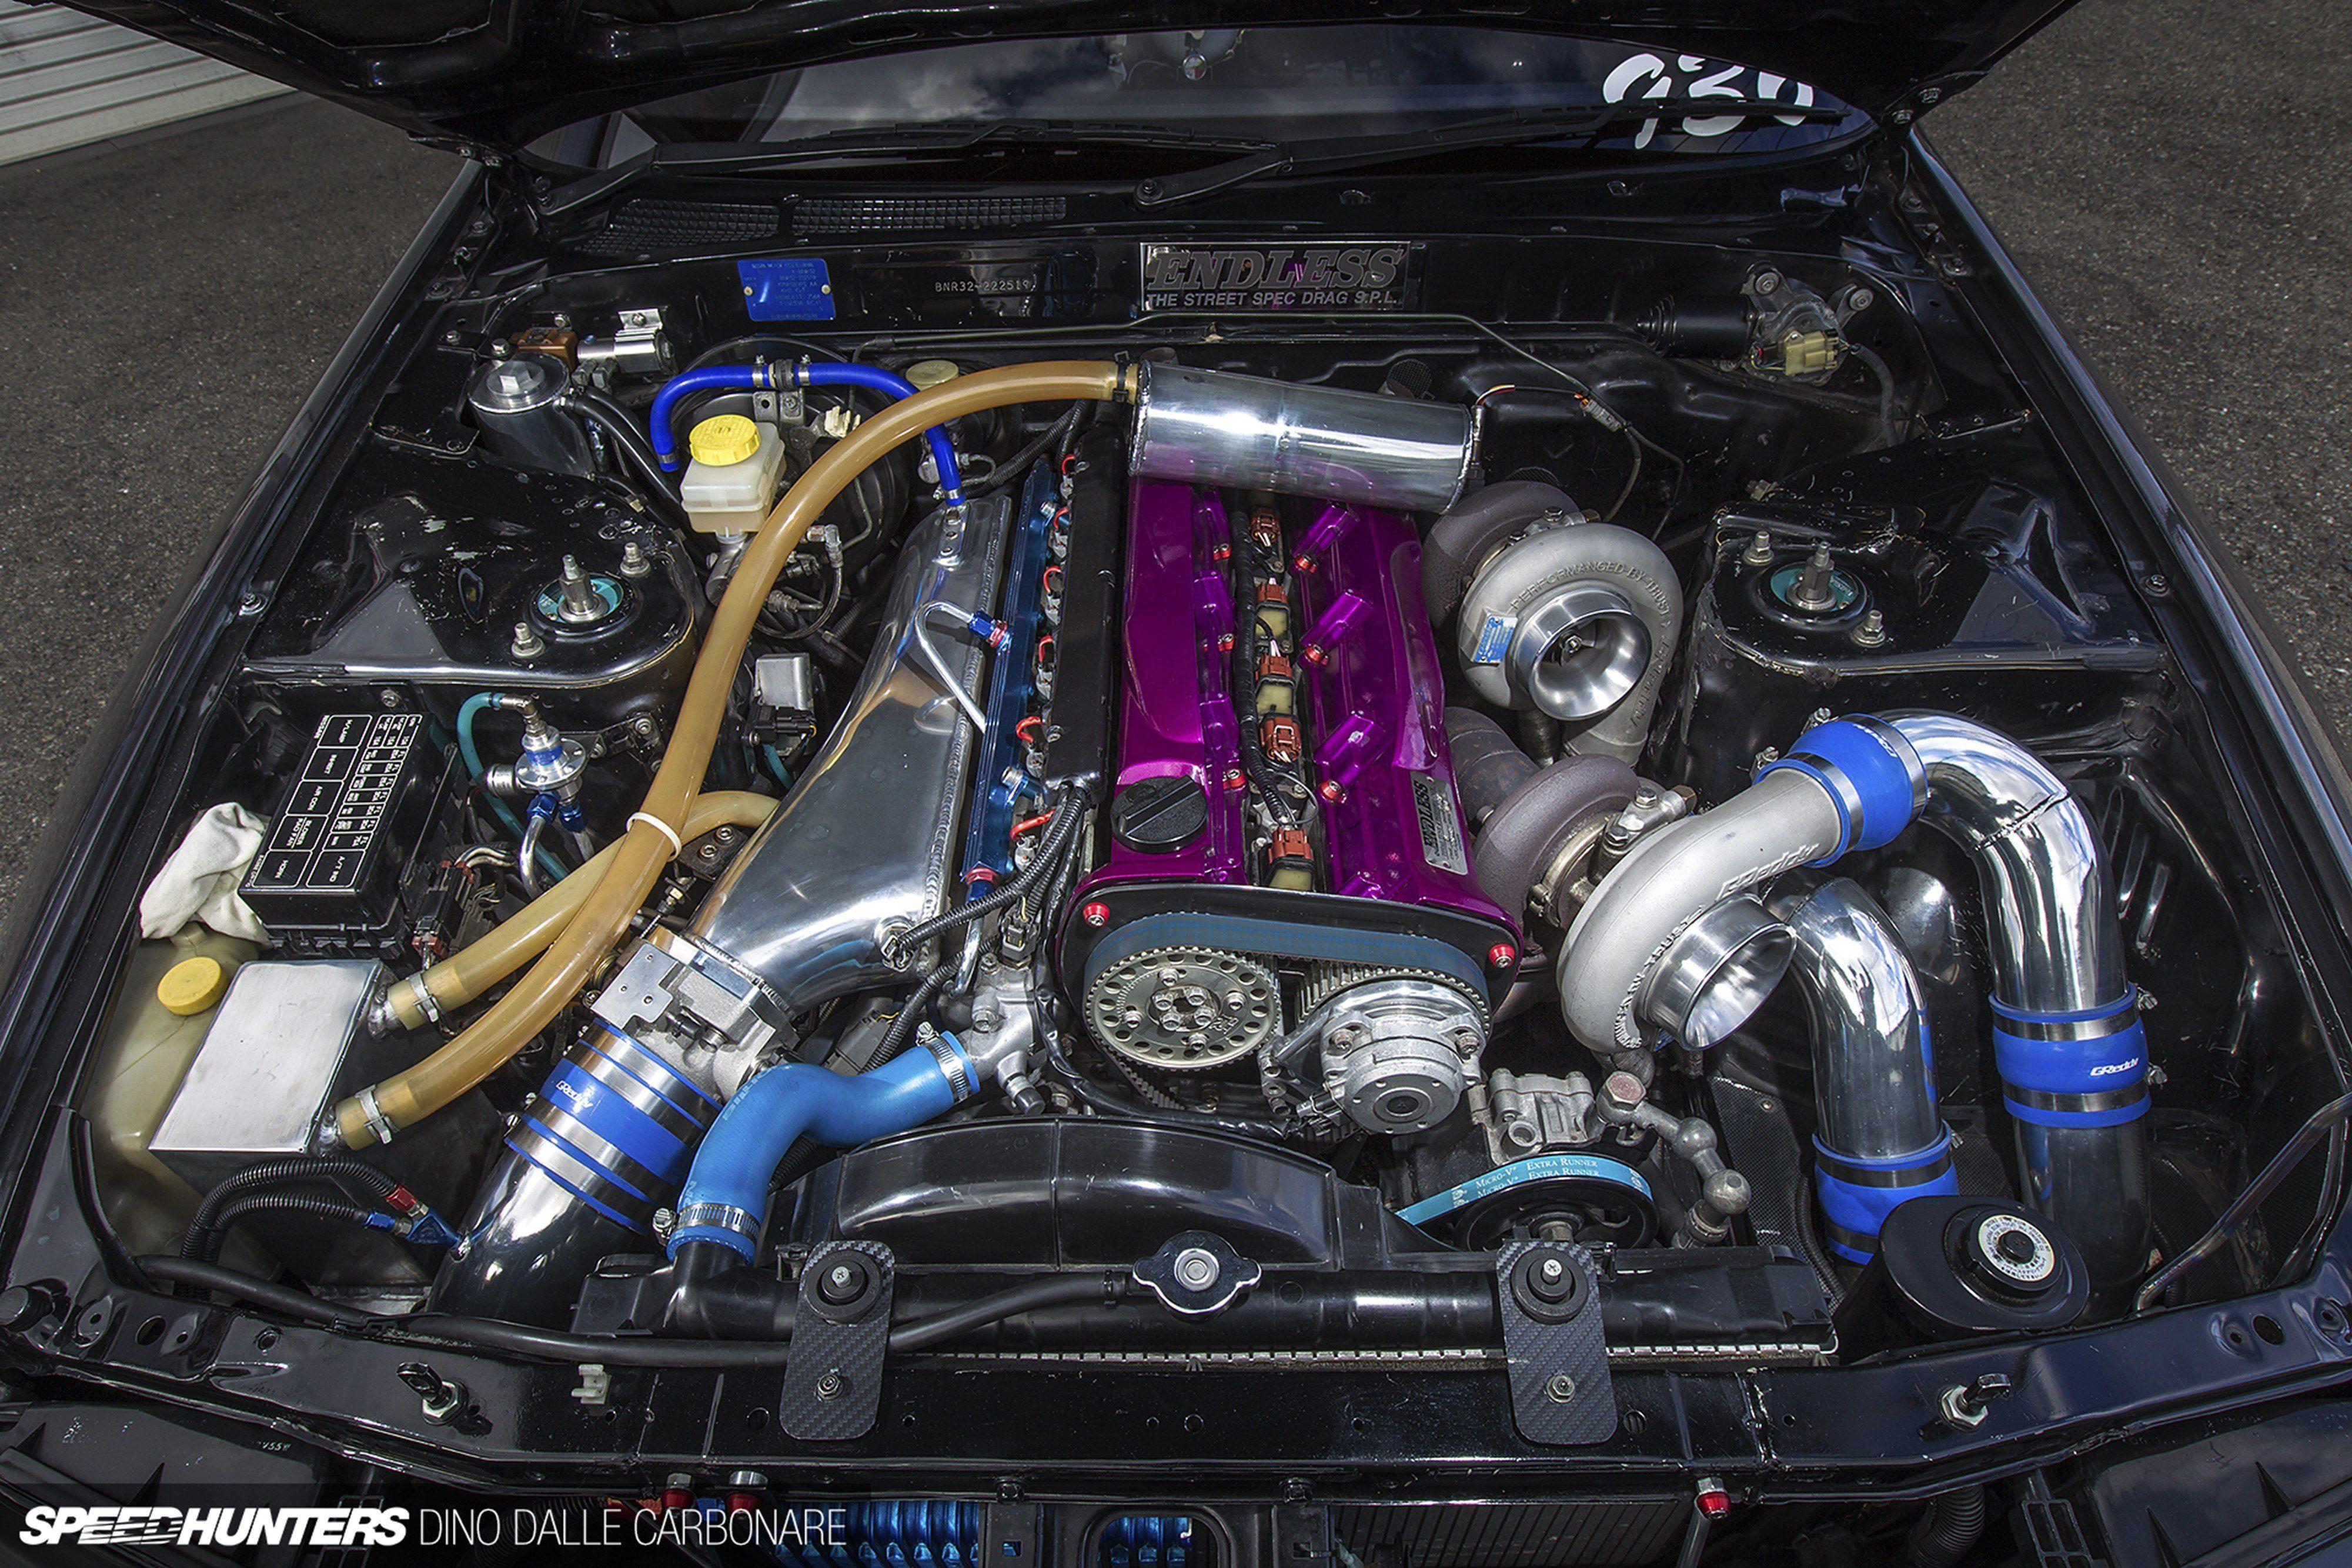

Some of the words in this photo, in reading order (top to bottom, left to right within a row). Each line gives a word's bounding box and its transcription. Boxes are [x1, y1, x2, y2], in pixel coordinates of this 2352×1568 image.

[1147, 248, 1404, 290] ENDLESS
[1147, 294, 1178, 306] THE
[1184, 293, 1247, 306] STREET
[1252, 292, 1295, 305] SPEC
[1301, 291, 1348, 305] DRAG
[308, 797, 318, 810] CON
[2090, 1057, 2140, 1077] GReddy
